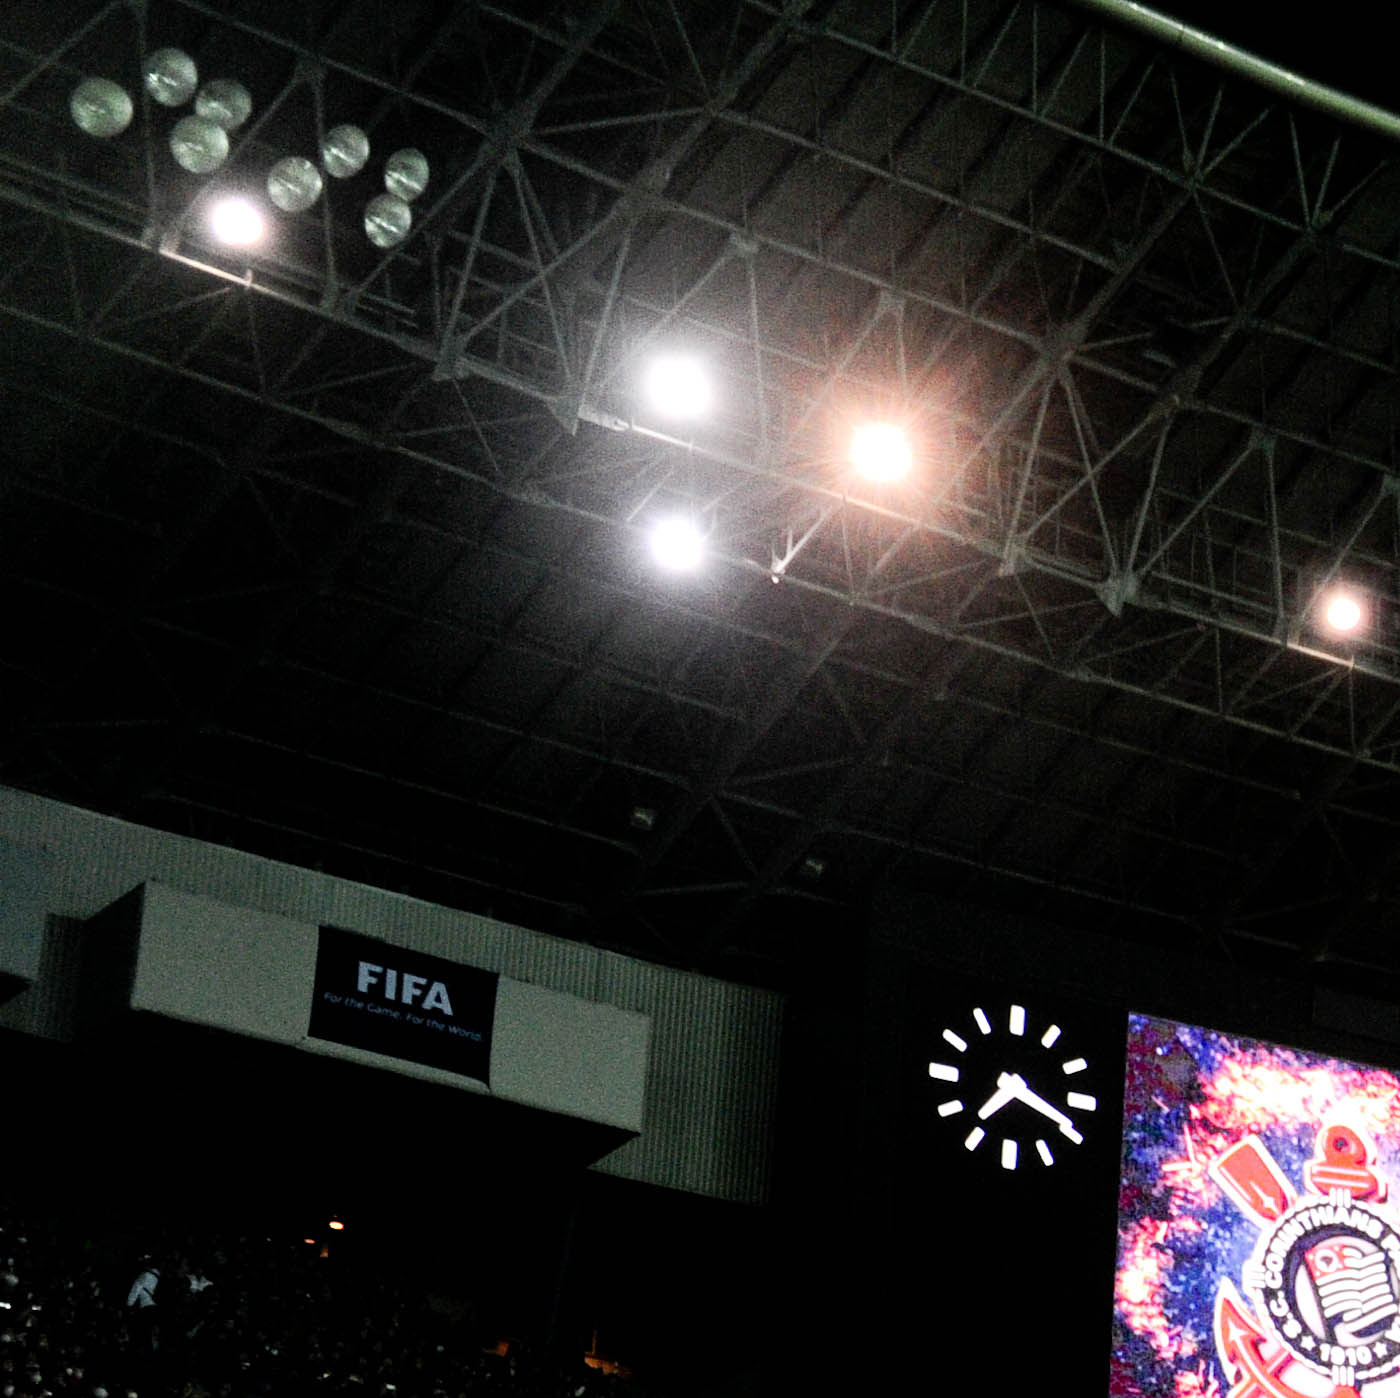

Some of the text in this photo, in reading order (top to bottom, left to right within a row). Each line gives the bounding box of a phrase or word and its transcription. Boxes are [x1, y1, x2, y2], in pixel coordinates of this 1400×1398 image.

[357, 960, 453, 1016] FIFA
[323, 991, 342, 1003] For
[344, 996, 364, 1009] the
[1319, 1343, 1373, 1366] 1910
